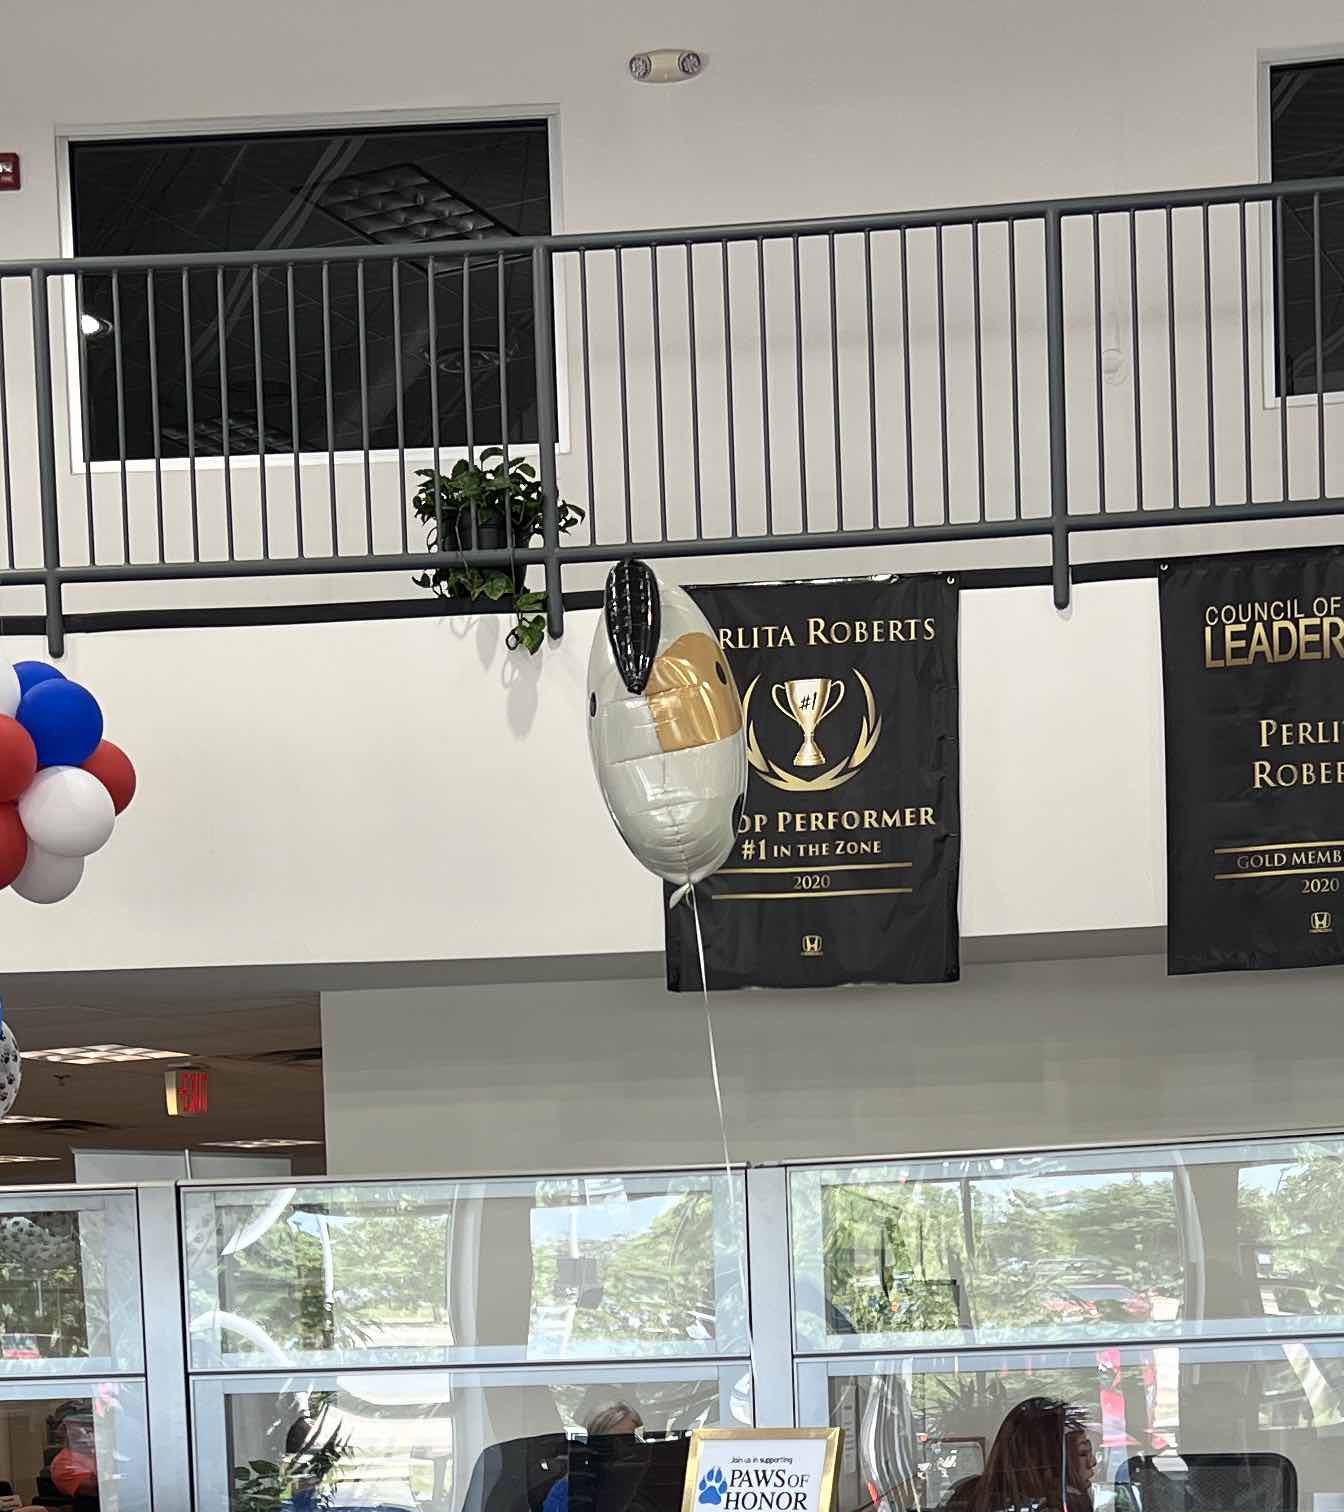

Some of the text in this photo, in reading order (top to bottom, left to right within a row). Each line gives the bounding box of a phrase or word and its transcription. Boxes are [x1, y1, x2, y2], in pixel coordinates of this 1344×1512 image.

[1205, 599, 1305, 626] COUNCIL
[1313, 597, 1341, 615] OF
[719, 617, 936, 651] RLITA ROBERTS
[799, 690, 818, 712] #1
[737, 806, 936, 833] OP PERFORMER
[741, 840, 882, 861] #1 IN THE ZONE
[1237, 852, 1287, 869] GOLD
[793, 874, 831, 890] 2020
[1301, 878, 1340, 894] 2020
[730, 1469, 810, 1488] PAWS OF
[723, 1491, 808, 1510] HONOR
